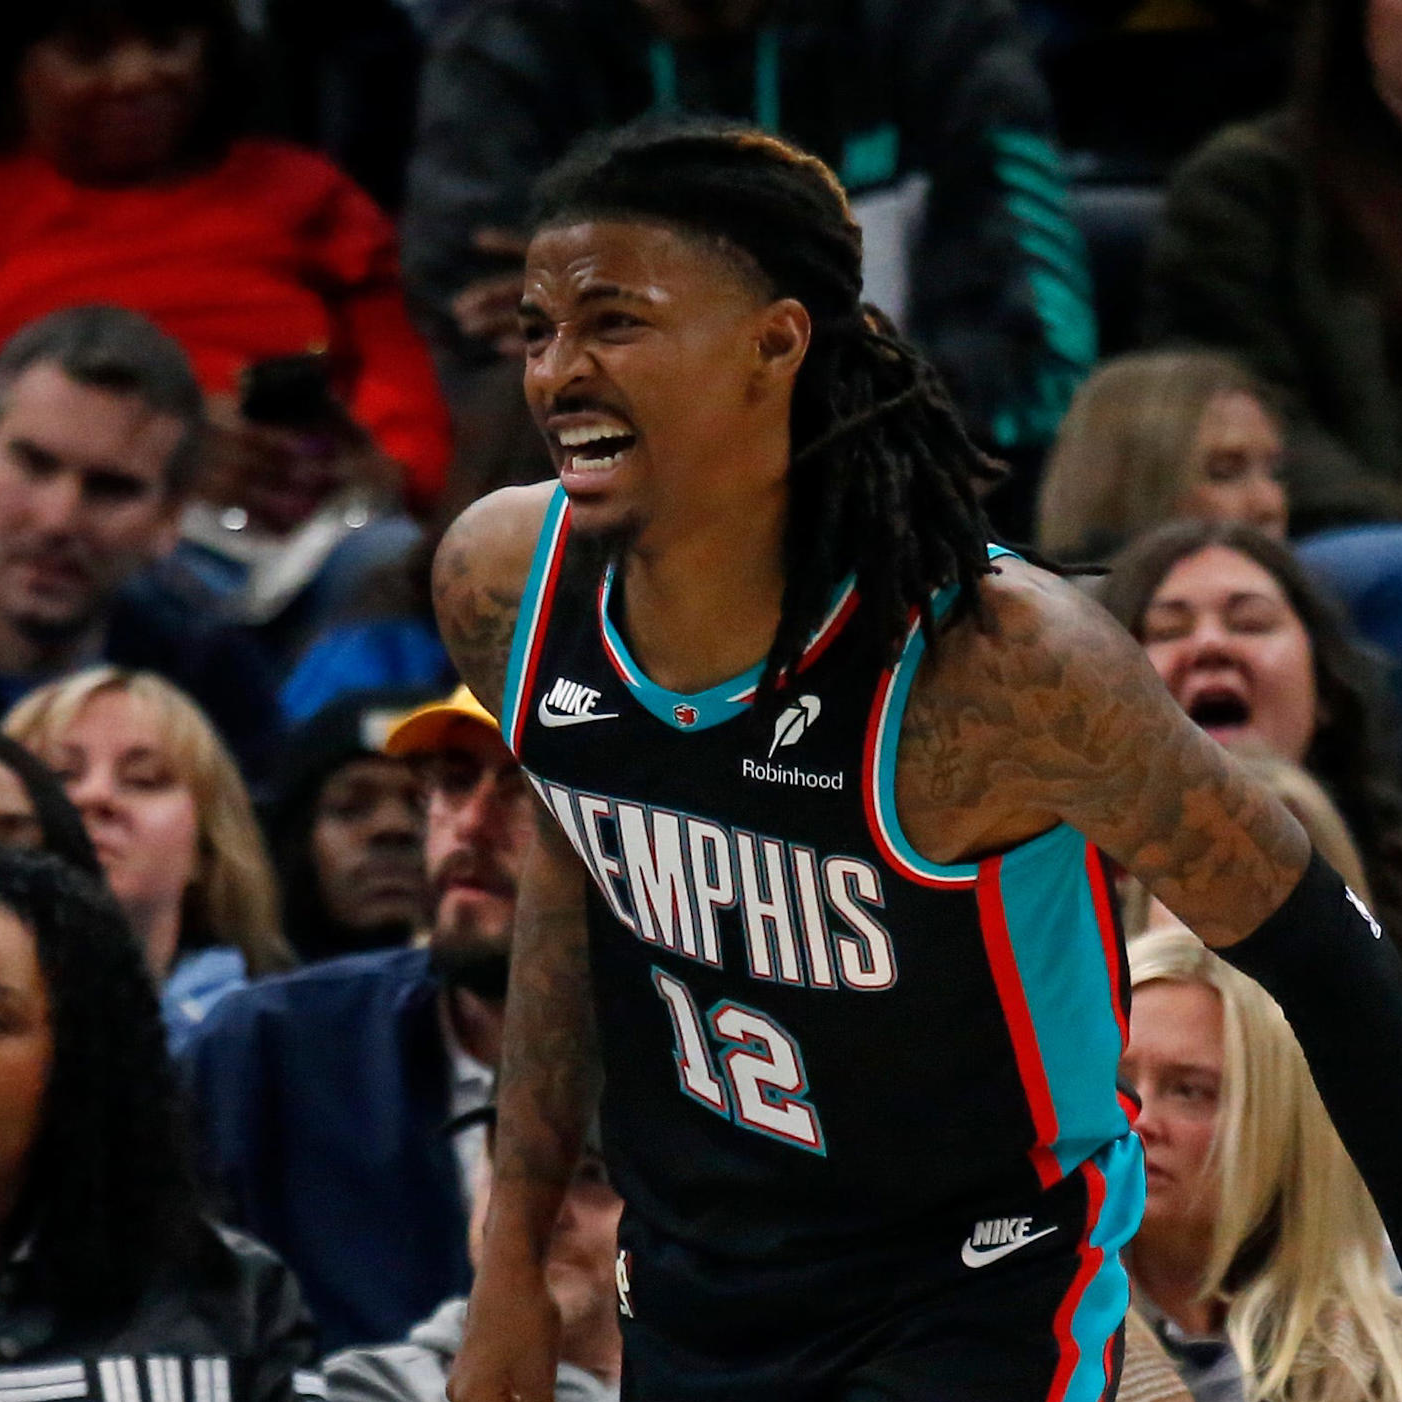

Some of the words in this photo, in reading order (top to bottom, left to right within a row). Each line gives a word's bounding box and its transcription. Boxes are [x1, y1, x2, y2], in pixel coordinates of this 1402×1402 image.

[546, 676, 602, 716] NIKE
[742, 758, 843, 790] Robinhood
[650, 964, 827, 1159] 12
[971, 1217, 1033, 1247] NIKE
